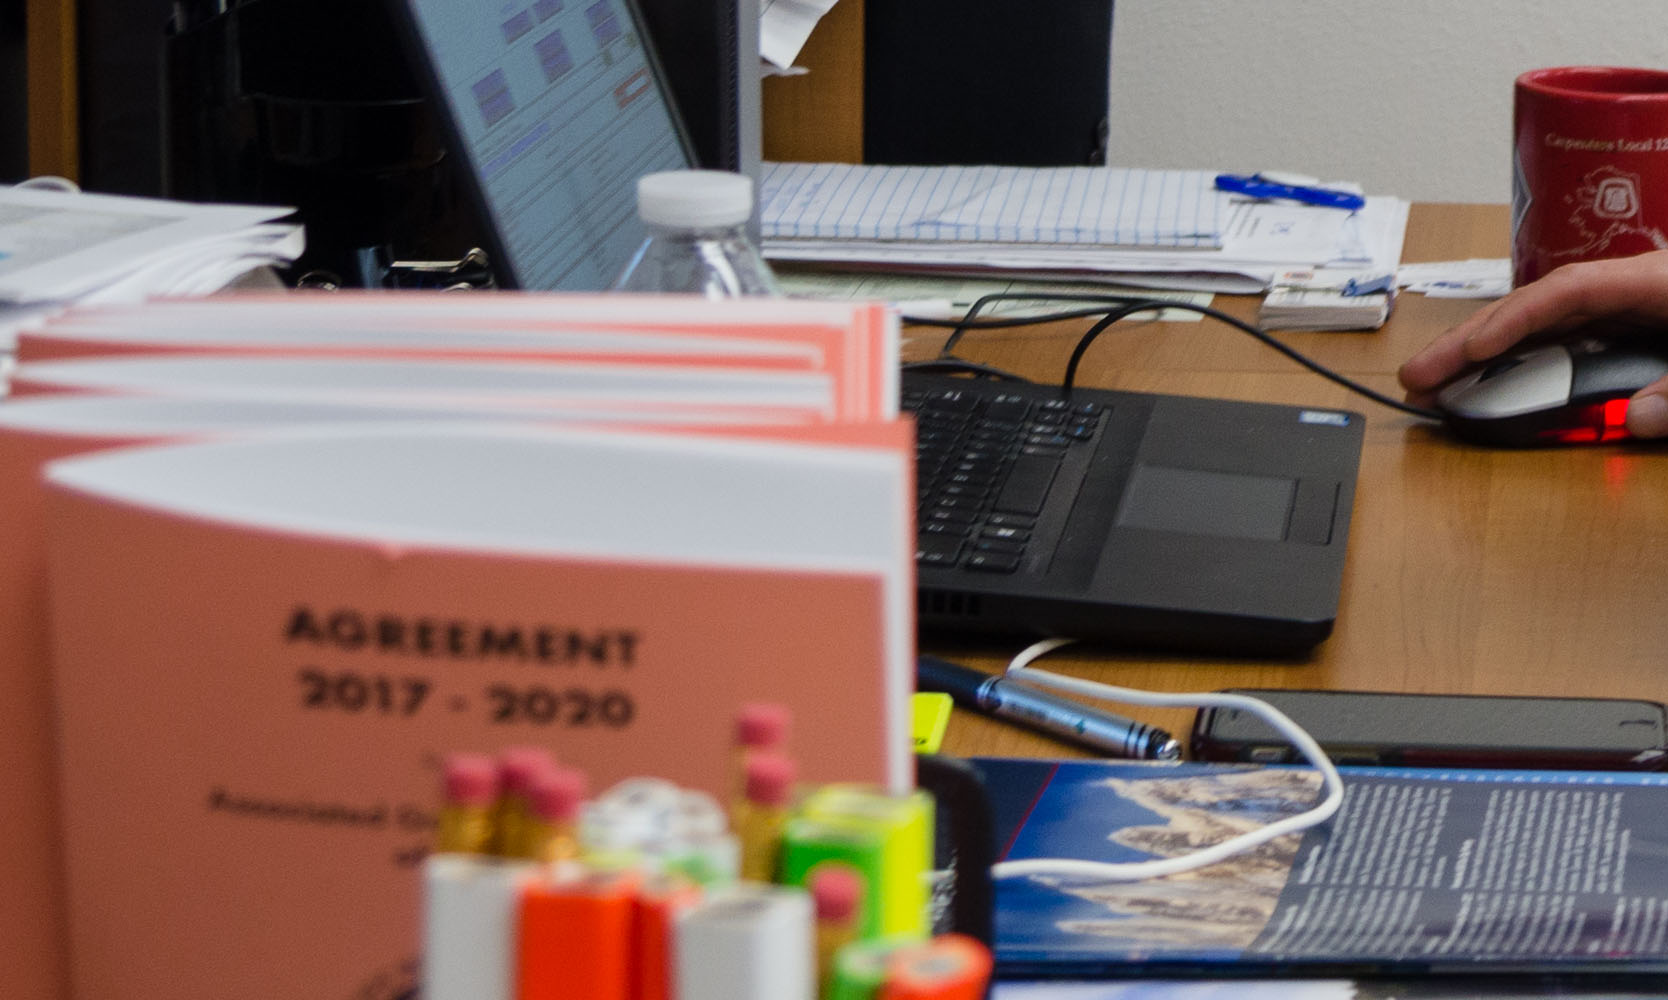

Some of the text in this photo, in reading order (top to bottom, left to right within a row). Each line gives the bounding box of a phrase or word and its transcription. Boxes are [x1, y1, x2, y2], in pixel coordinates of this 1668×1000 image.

[1617, 137, 1653, 151] Local
[285, 605, 639, 667] AGREEMENT
[298, 669, 430, 715] 2017
[486, 684, 637, 728] 2020
